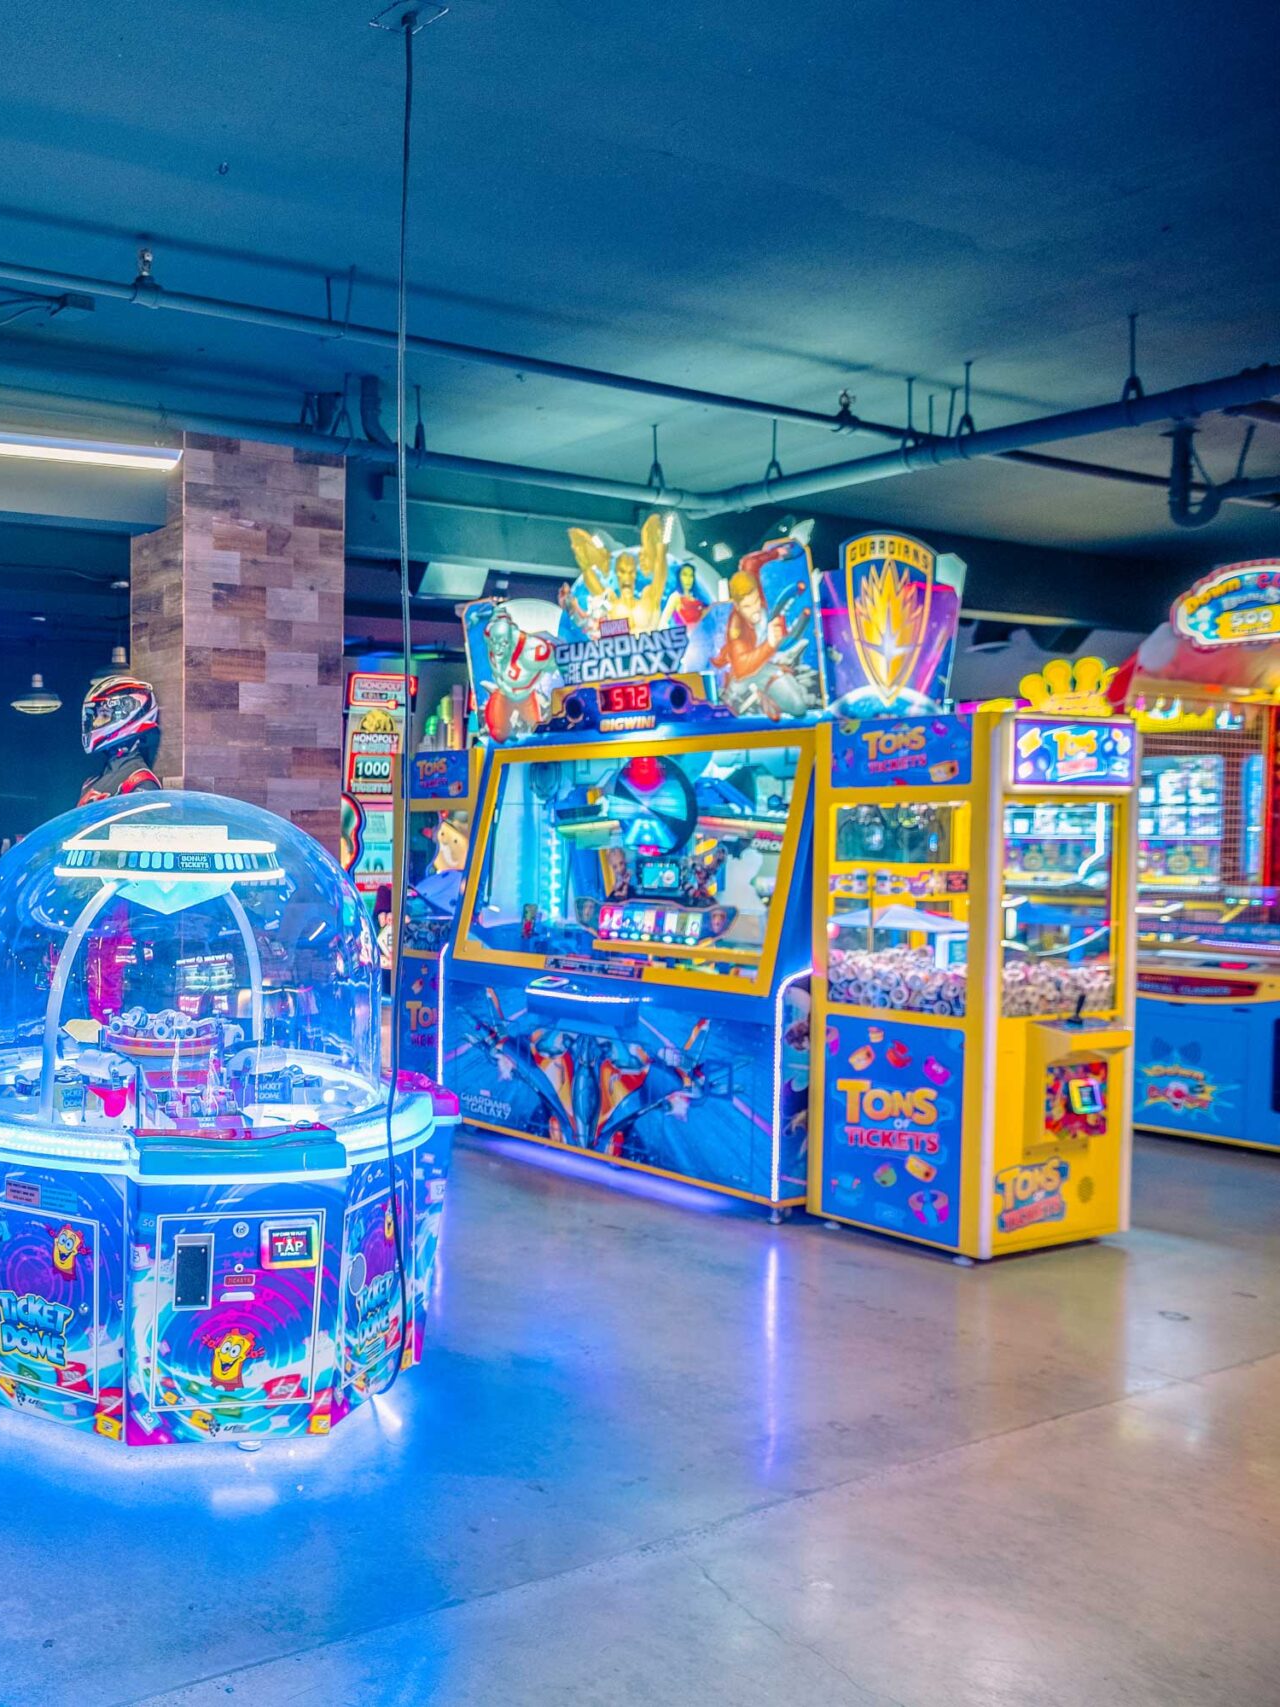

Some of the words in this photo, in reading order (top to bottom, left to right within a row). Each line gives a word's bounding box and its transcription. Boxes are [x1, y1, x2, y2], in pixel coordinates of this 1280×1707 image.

[850, 540, 928, 569] GUARDIANS
[1231, 609, 1273, 626] 500
[555, 626, 689, 666] GUARDIANS
[581, 648, 686, 683] GALAXY
[360, 681, 401, 692] MONOPOLY
[613, 686, 647, 710] 572
[353, 734, 399, 743] MONOPOLY
[861, 725, 926, 760] TONS
[1053, 730, 1098, 761] TONS
[357, 762, 390, 775] 1000
[868, 754, 927, 773] TICKETS
[751, 838, 784, 853] DRO
[180, 861, 209, 869] TICKETS
[405, 1001, 438, 1031] TO
[461, 1092, 511, 1111] GUARDIANS
[471, 1103, 511, 1120] GALAXY
[836, 1078, 938, 1126] TONS
[844, 1126, 939, 1153] TICKETS
[998, 1157, 1060, 1209] TONS
[275, 1239, 304, 1253] TAP
[227, 1276, 252, 1284] TICKETS
[361, 1278, 393, 1314] TICKET
[360, 1313, 391, 1343] DOME
[1, 1322, 66, 1366] DOME
